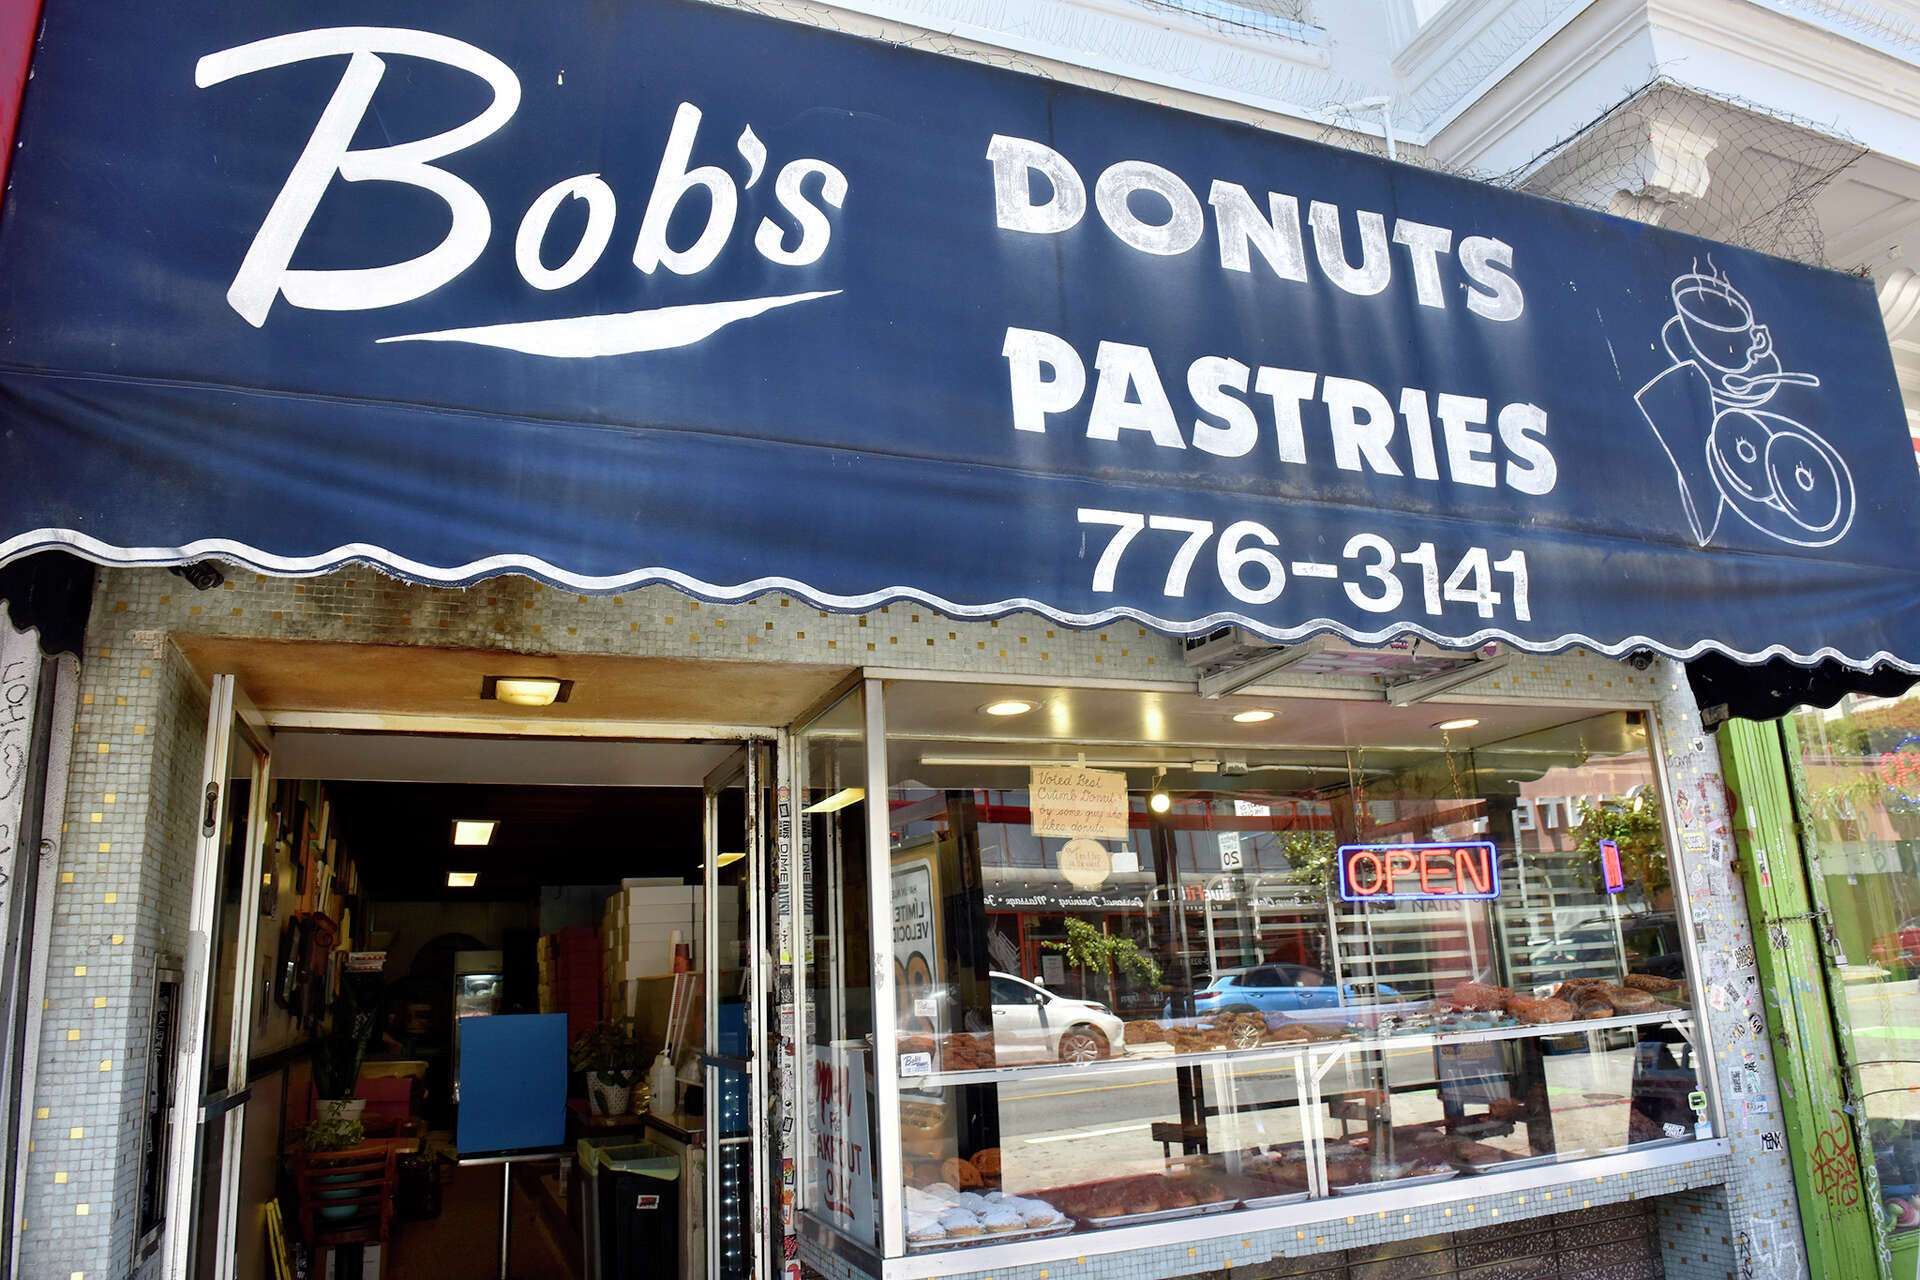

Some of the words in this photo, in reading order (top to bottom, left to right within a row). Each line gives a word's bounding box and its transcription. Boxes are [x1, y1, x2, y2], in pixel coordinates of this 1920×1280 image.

[195, 26, 848, 328] Bob's
[985, 133, 1525, 322] DONUTS
[1002, 326, 1558, 495] PASTRIES
[1076, 508, 1531, 622] 776-3141
[1038, 772, 1072, 786] Voted
[1041, 819, 1065, 832] likes
[1347, 848, 1491, 896] OPEN
